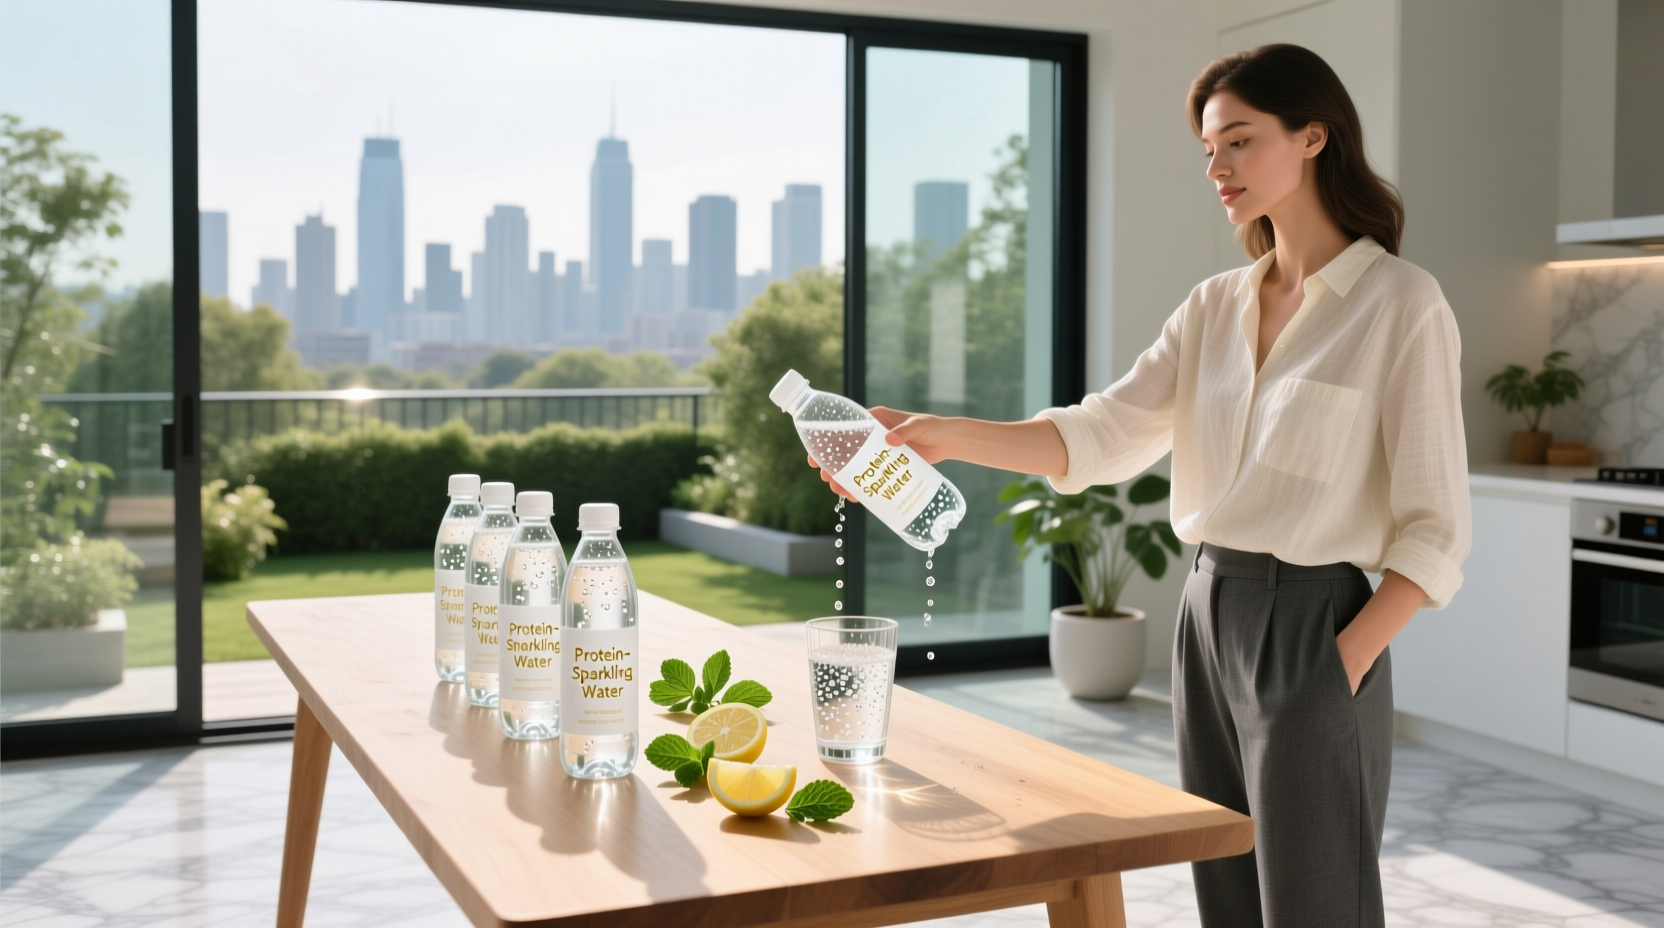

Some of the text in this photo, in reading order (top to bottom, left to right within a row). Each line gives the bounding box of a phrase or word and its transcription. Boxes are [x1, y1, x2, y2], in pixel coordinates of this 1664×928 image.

[509, 622, 559, 636] Protein-
[574, 646, 631, 662] Protein-
[514, 655, 552, 668] Water
[582, 684, 624, 698] Water
